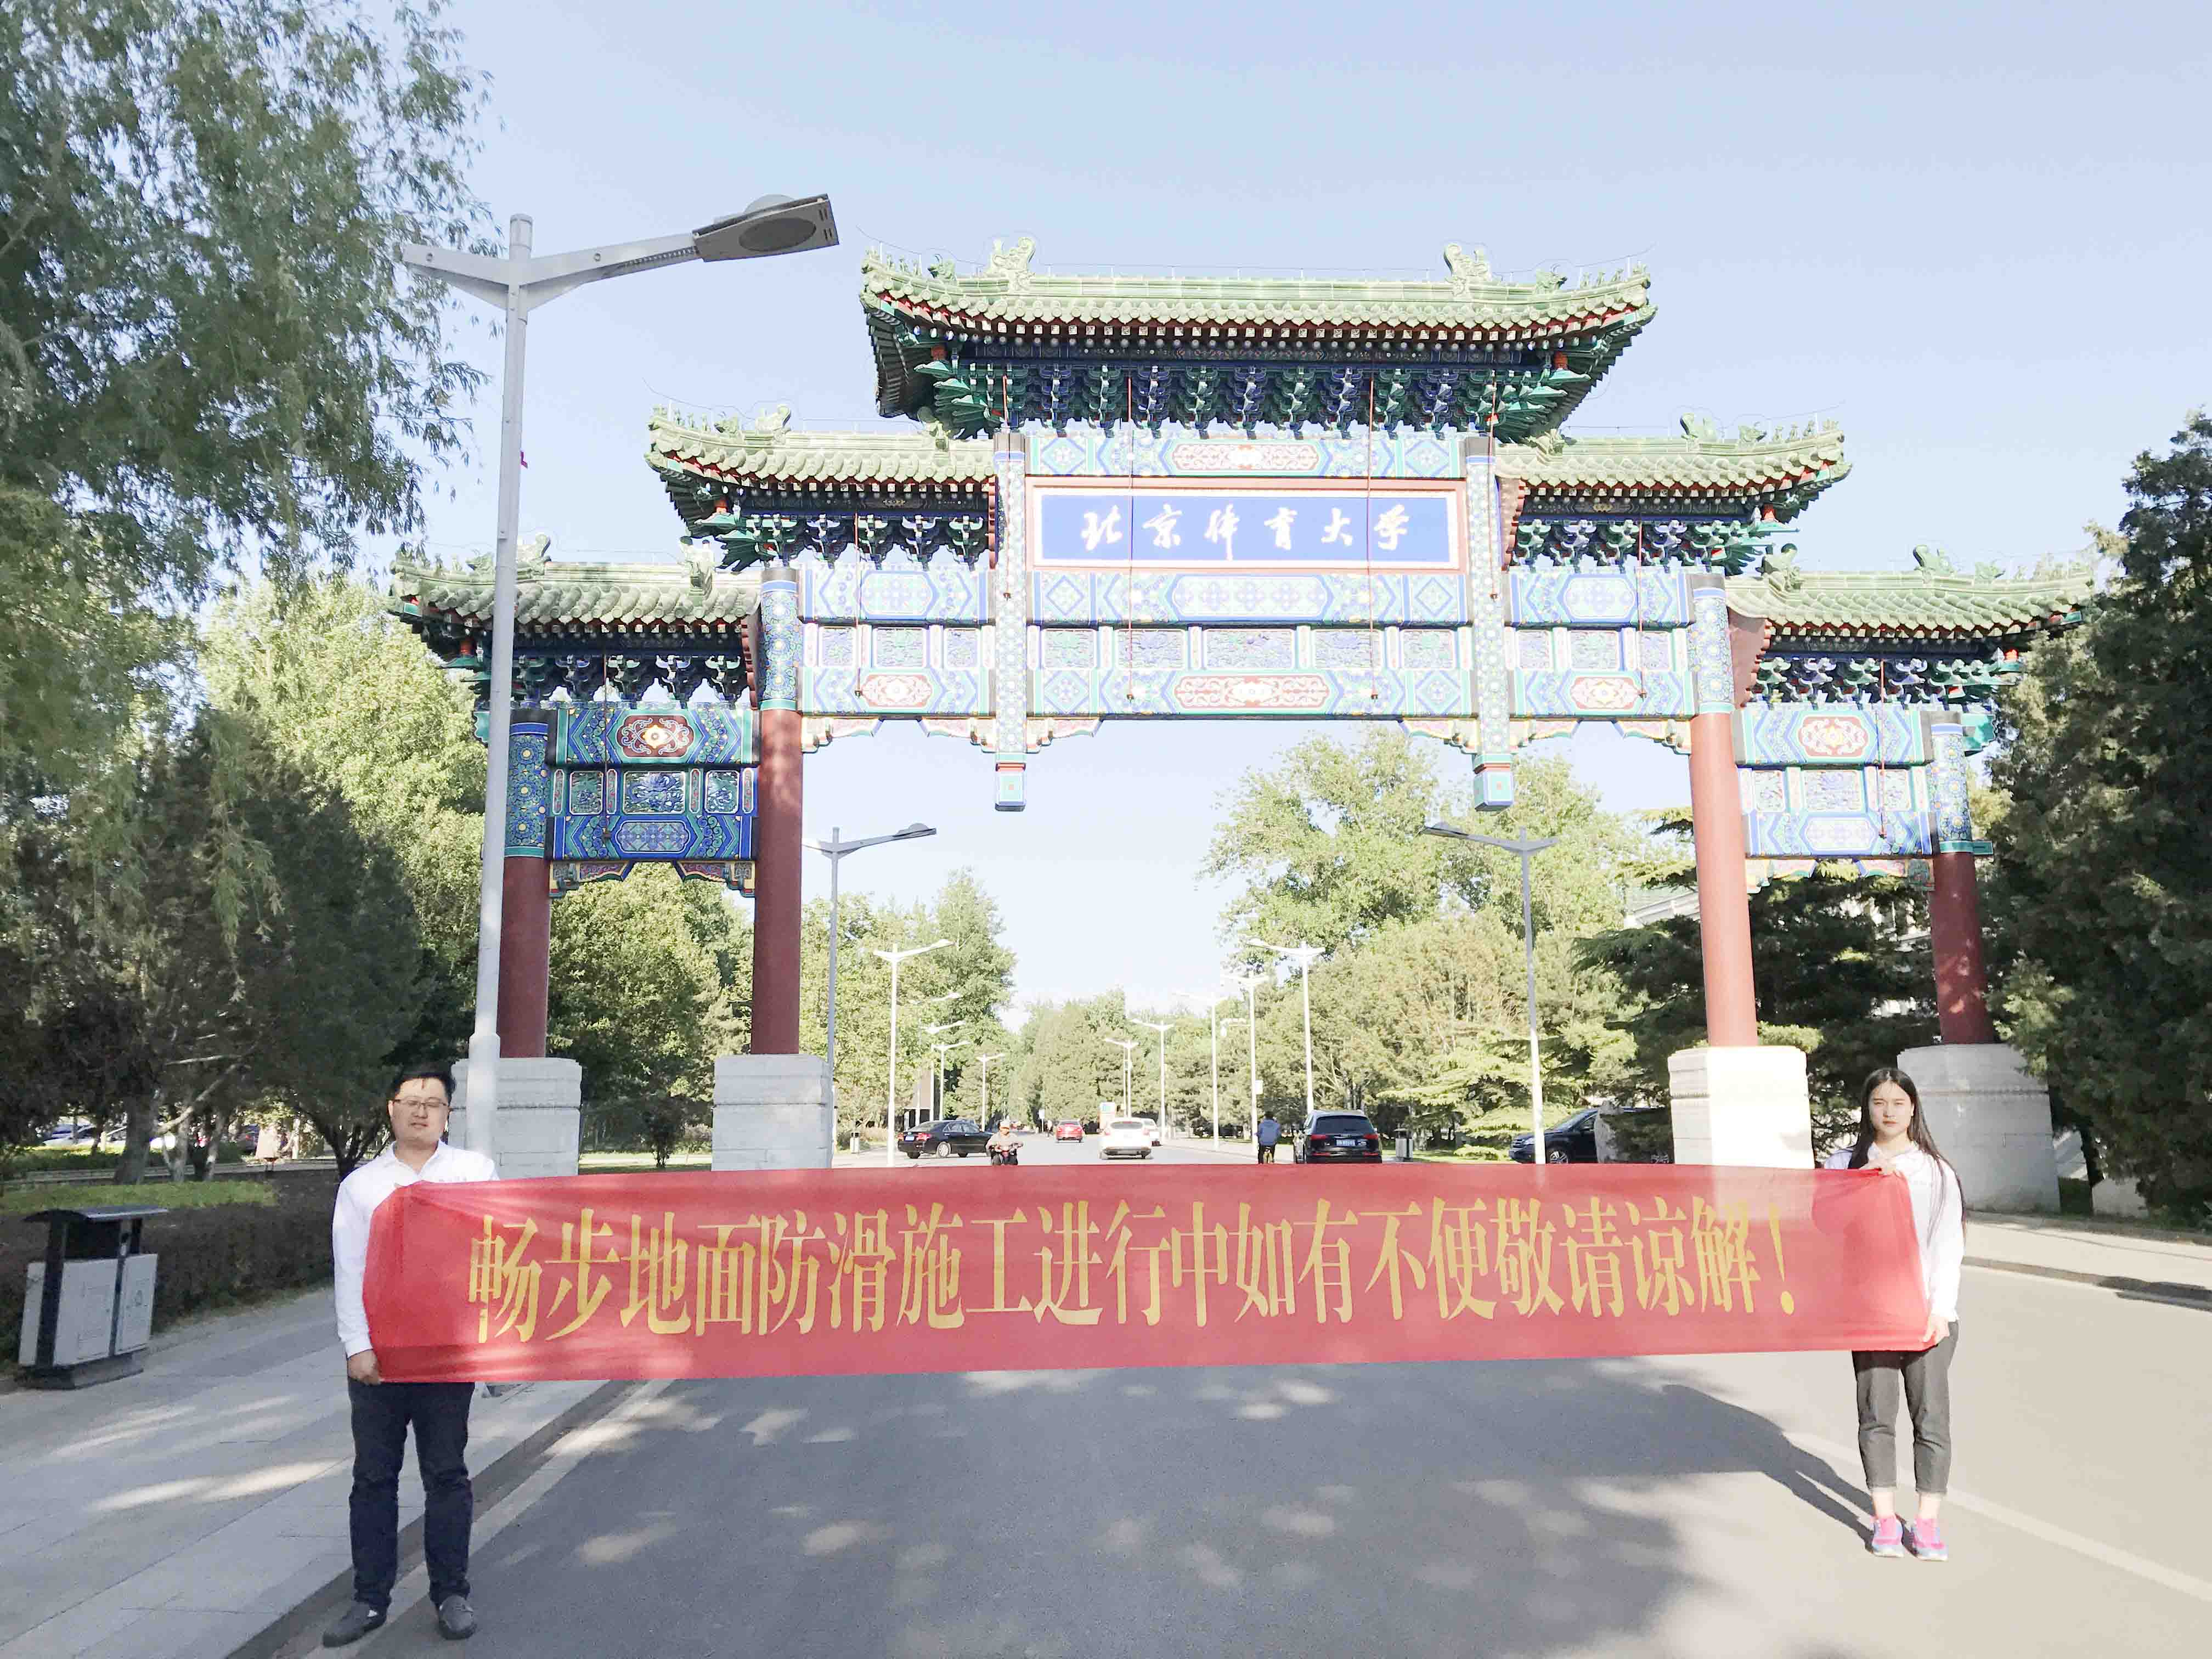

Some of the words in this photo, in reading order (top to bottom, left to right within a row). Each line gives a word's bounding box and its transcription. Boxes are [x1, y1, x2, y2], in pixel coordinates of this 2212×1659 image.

[1081, 503, 1410, 561] 北京体育大学
